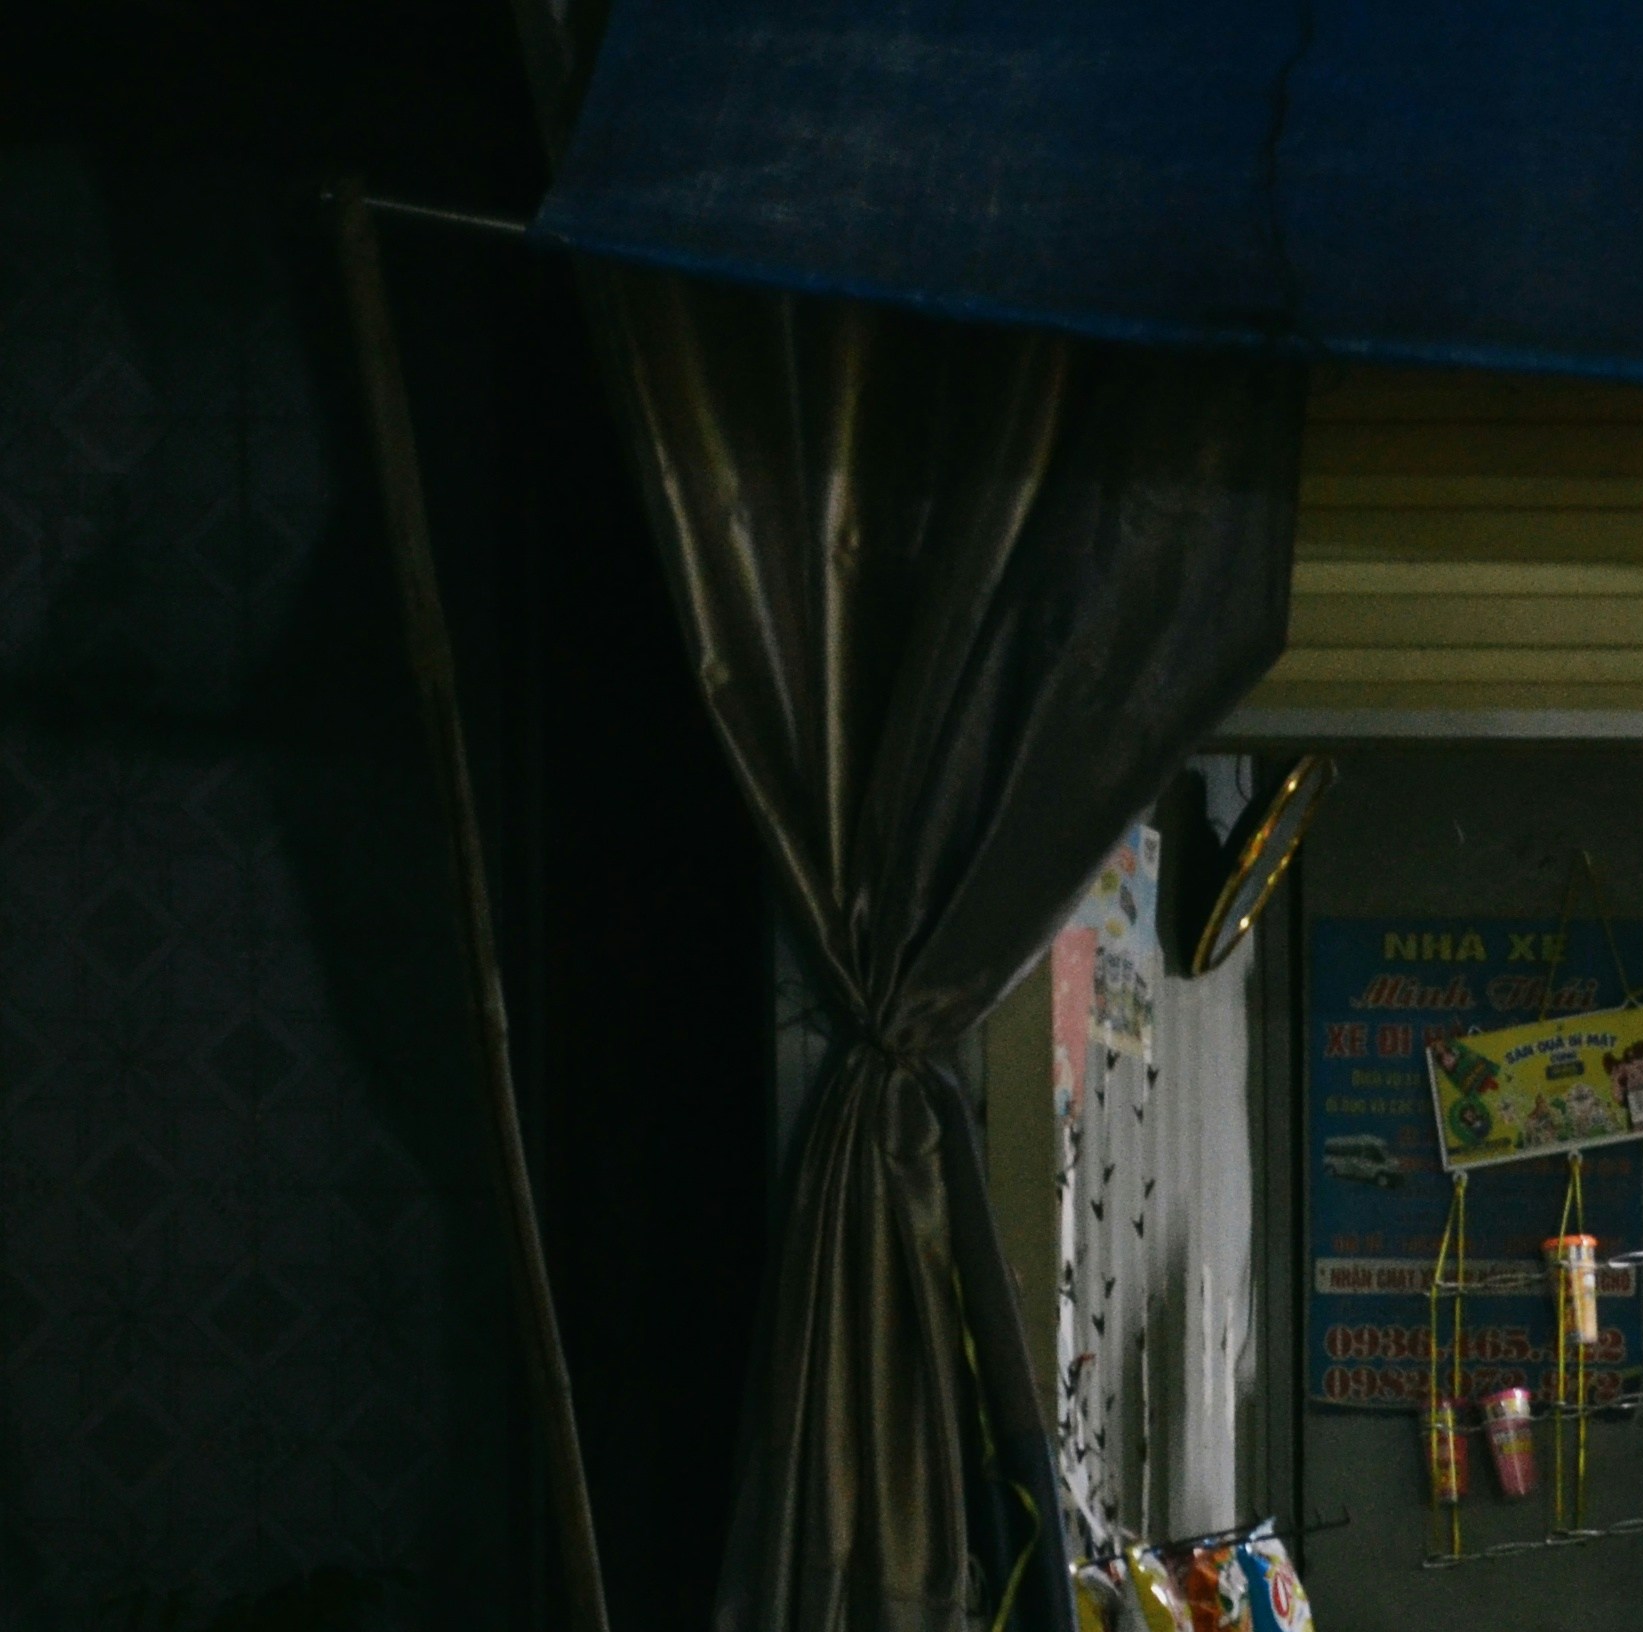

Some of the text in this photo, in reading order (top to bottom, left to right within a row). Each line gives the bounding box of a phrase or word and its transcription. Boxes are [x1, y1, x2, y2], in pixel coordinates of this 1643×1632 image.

[1382, 926, 1568, 964] NHÀ XE
[1323, 1022, 1368, 1058] XE
[1376, 1022, 1412, 1058] ĐI
